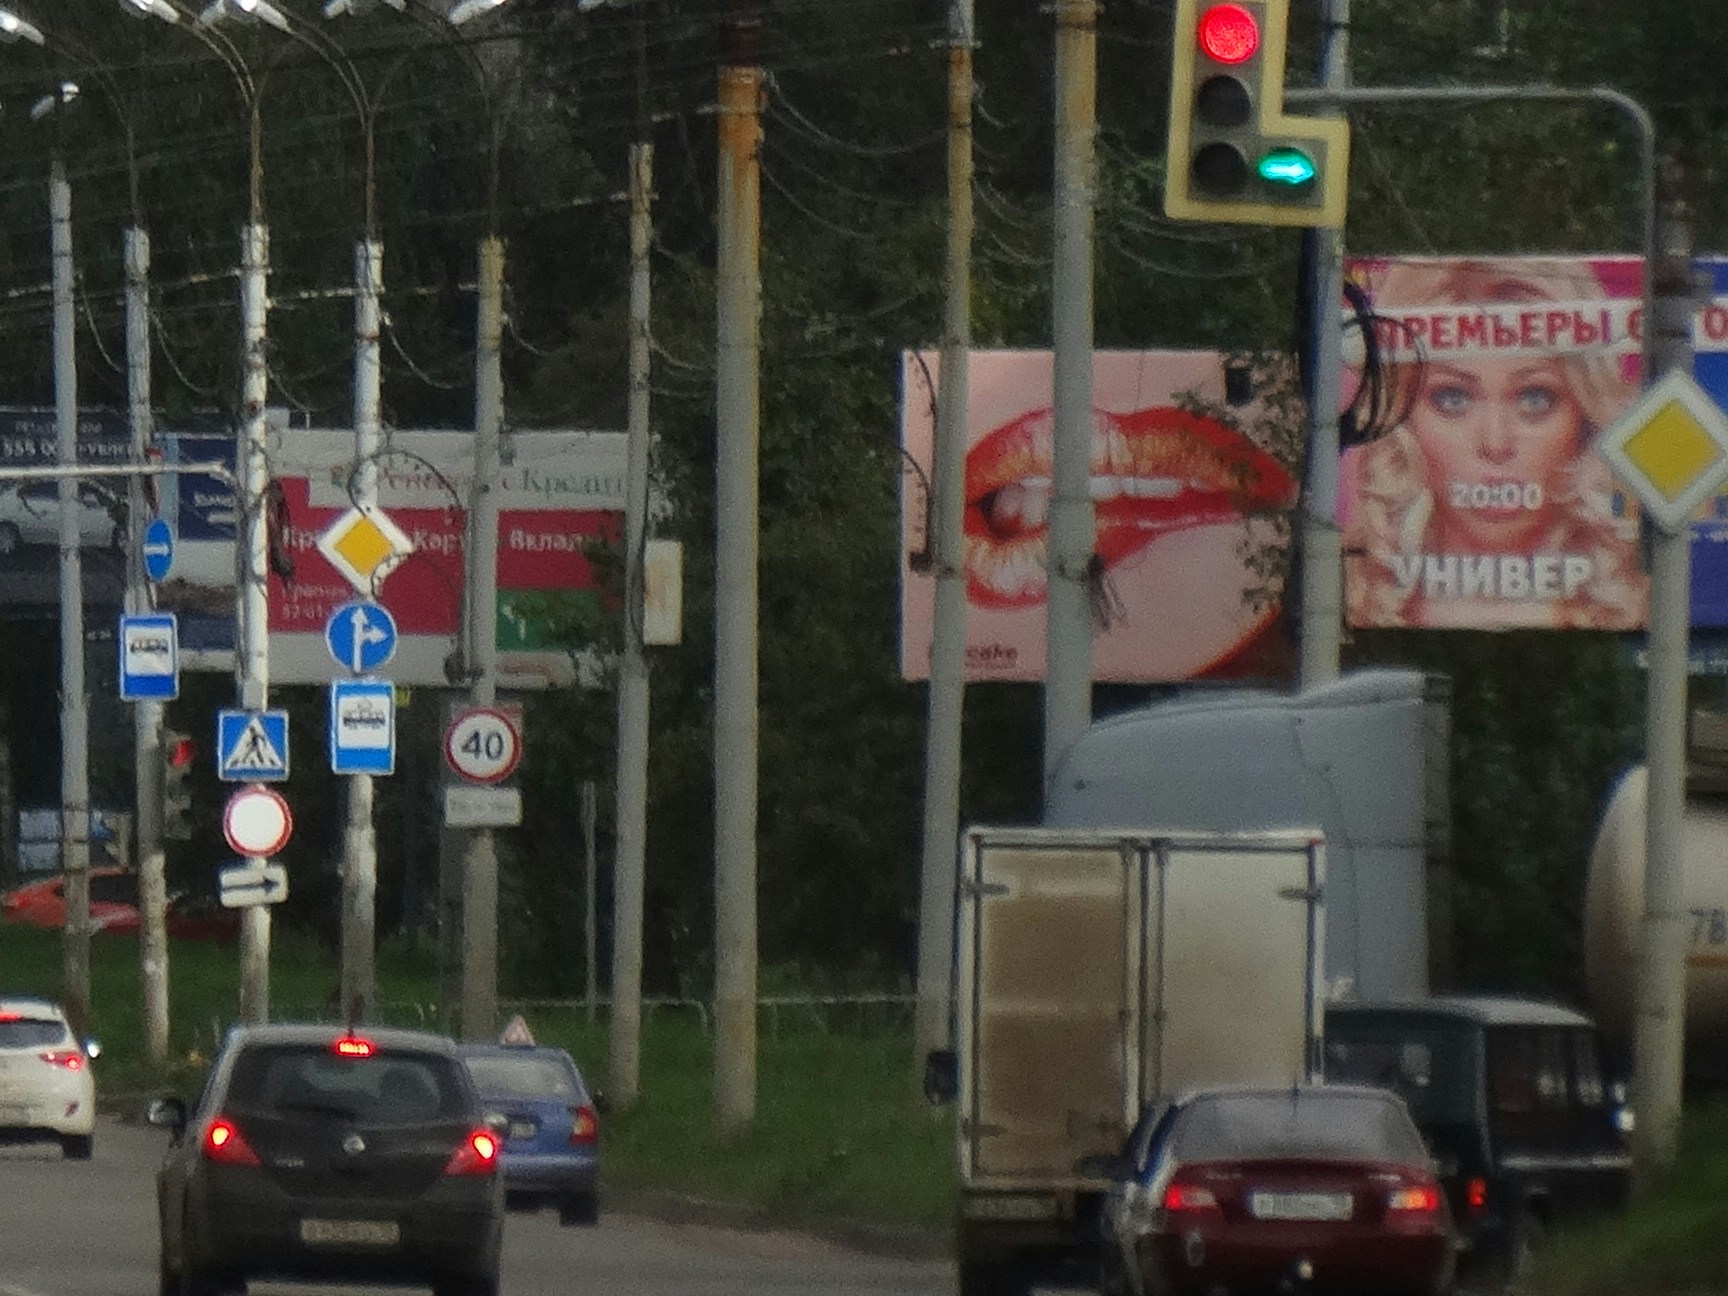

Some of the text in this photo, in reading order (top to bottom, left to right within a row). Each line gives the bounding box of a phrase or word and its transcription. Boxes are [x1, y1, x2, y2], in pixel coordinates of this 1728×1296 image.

[1375, 311, 1611, 351] ПРЕМЬЕРЫ
[1450, 481, 1543, 509] 20:00
[1394, 554, 1591, 598] УНИВЕР
[462, 730, 504, 760] 40
